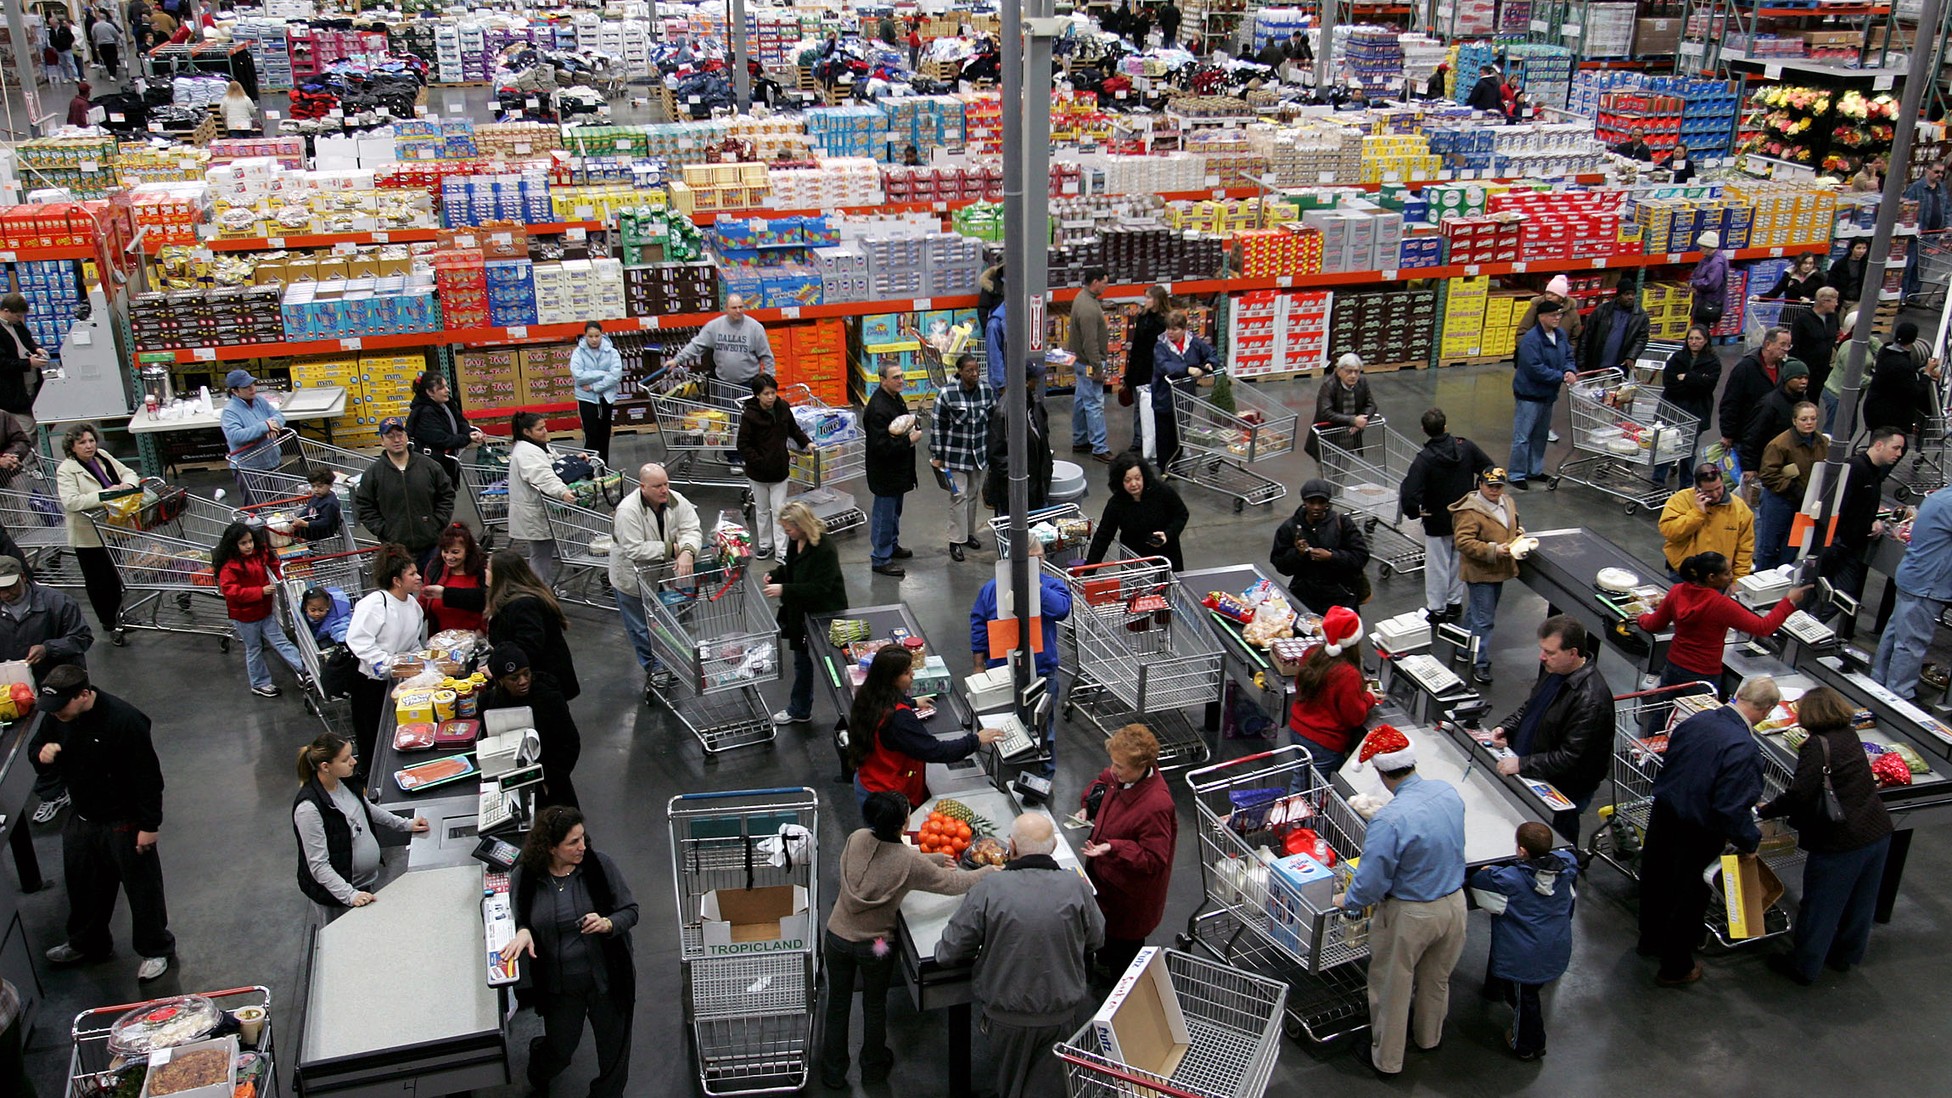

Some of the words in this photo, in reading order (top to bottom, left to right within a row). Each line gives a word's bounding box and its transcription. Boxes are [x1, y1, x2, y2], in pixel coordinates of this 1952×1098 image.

[717, 333, 747, 344] DALLAS
[714, 343, 748, 353] COWBOYS
[708, 939, 803, 955] TROPICLAND
